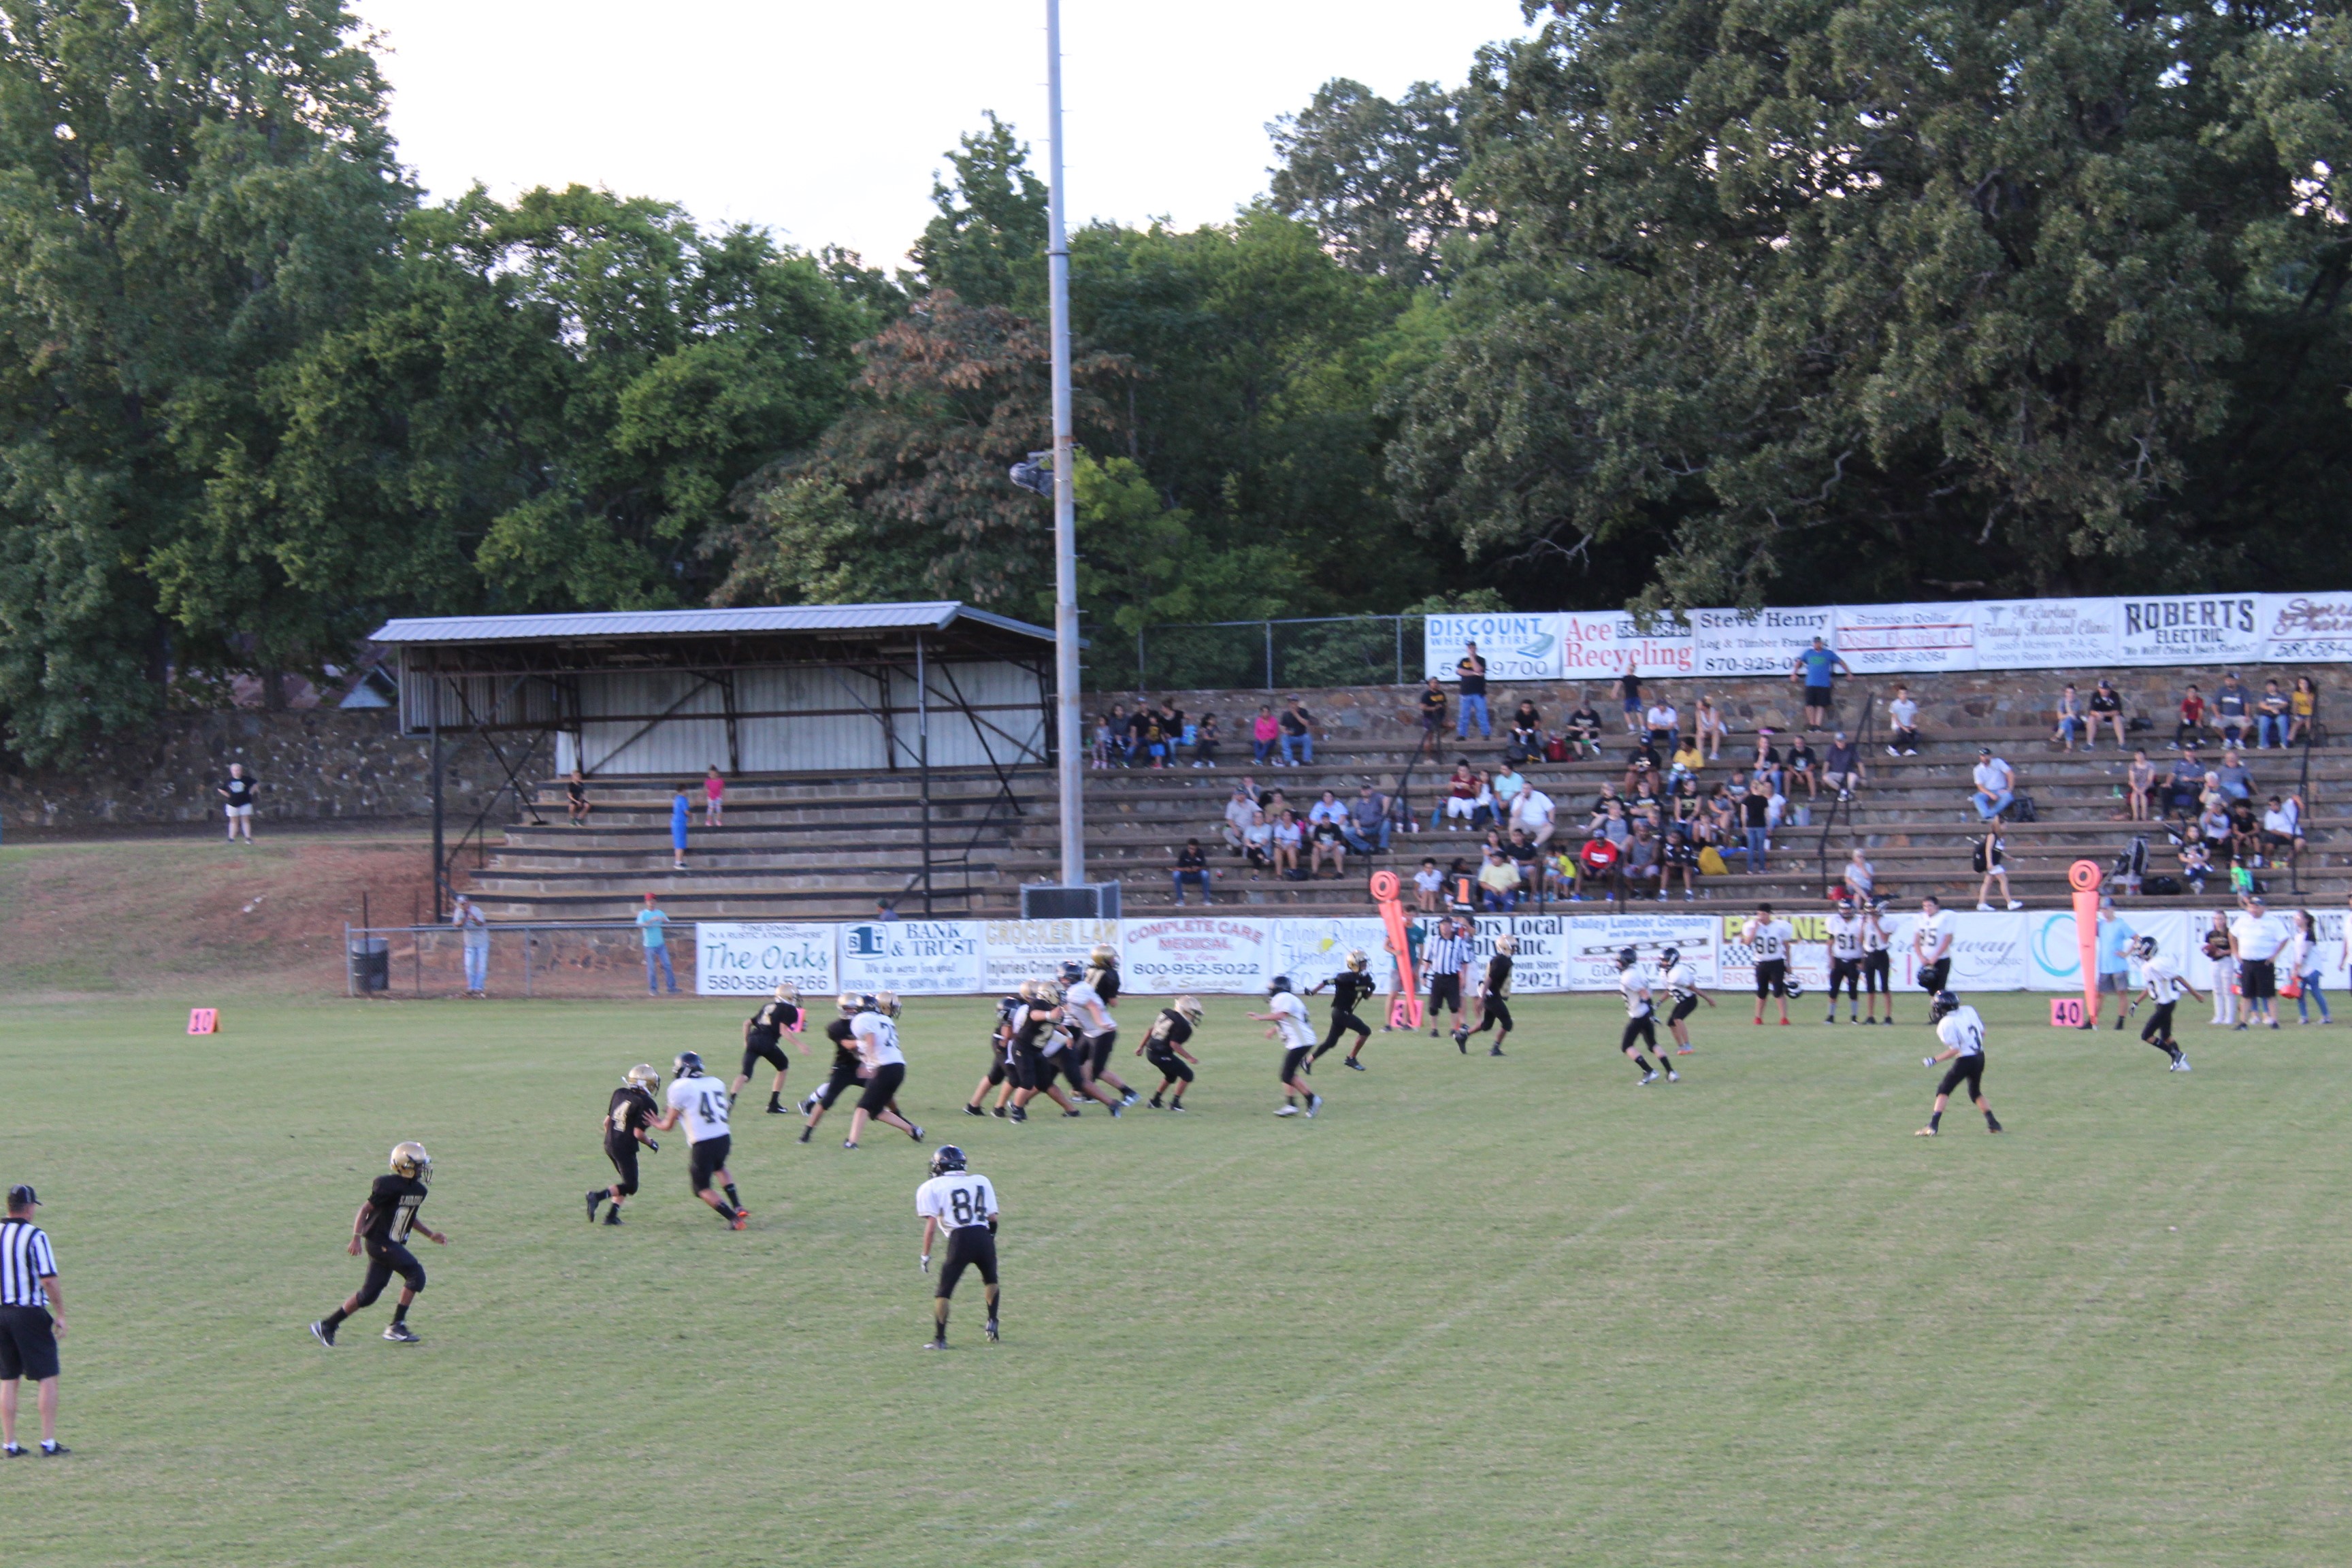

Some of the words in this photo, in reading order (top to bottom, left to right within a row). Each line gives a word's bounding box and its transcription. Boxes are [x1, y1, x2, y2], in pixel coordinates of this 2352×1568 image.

[1431, 618, 1541, 636] DISCOUNT
[1700, 612, 1758, 628] Steve
[1765, 612, 1828, 630] Henry
[1857, 614, 1911, 625] Brandon
[1914, 612, 1951, 623] Dollar
[2124, 600, 2254, 636] ROBERTS
[1565, 616, 1612, 642] Ace
[2156, 627, 2223, 643] ELECTRIC
[1484, 636, 1492, 645] &
[1499, 636, 1530, 645] TIRE
[1700, 638, 1720, 650] Log
[1724, 639, 1733, 648] &
[1737, 637, 1777, 648] Timber
[1838, 631, 1880, 647] Dollar
[1886, 630, 1938, 646] Electric
[1943, 630, 1972, 644] LLC
[1565, 640, 1694, 672] Recycling
[1457, 878, 1470, 904] 1
[905, 923, 962, 939] BANK
[986, 921, 1073, 945] CROCKER
[1079, 920, 1118, 944] LAW
[1128, 919, 1215, 943] COMPLETE
[1218, 921, 1265, 946] CARE
[1511, 919, 1563, 934] Local
[891, 941, 904, 957] &
[911, 938, 977, 956] TRUST
[1158, 937, 1233, 951] MEDICAL
[1755, 936, 1778, 954] 88
[1838, 933, 1857, 950] 51
[705, 942, 755, 969] The
[762, 942, 828, 971] Oaks
[986, 960, 1027, 977] Injuries
[1133, 963, 1260, 975] 800-952-5022
[2055, 1001, 2080, 1024] 40
[612, 1099, 632, 1132] 4
[700, 1091, 729, 1124] 45
[951, 1185, 987, 1224] 84
